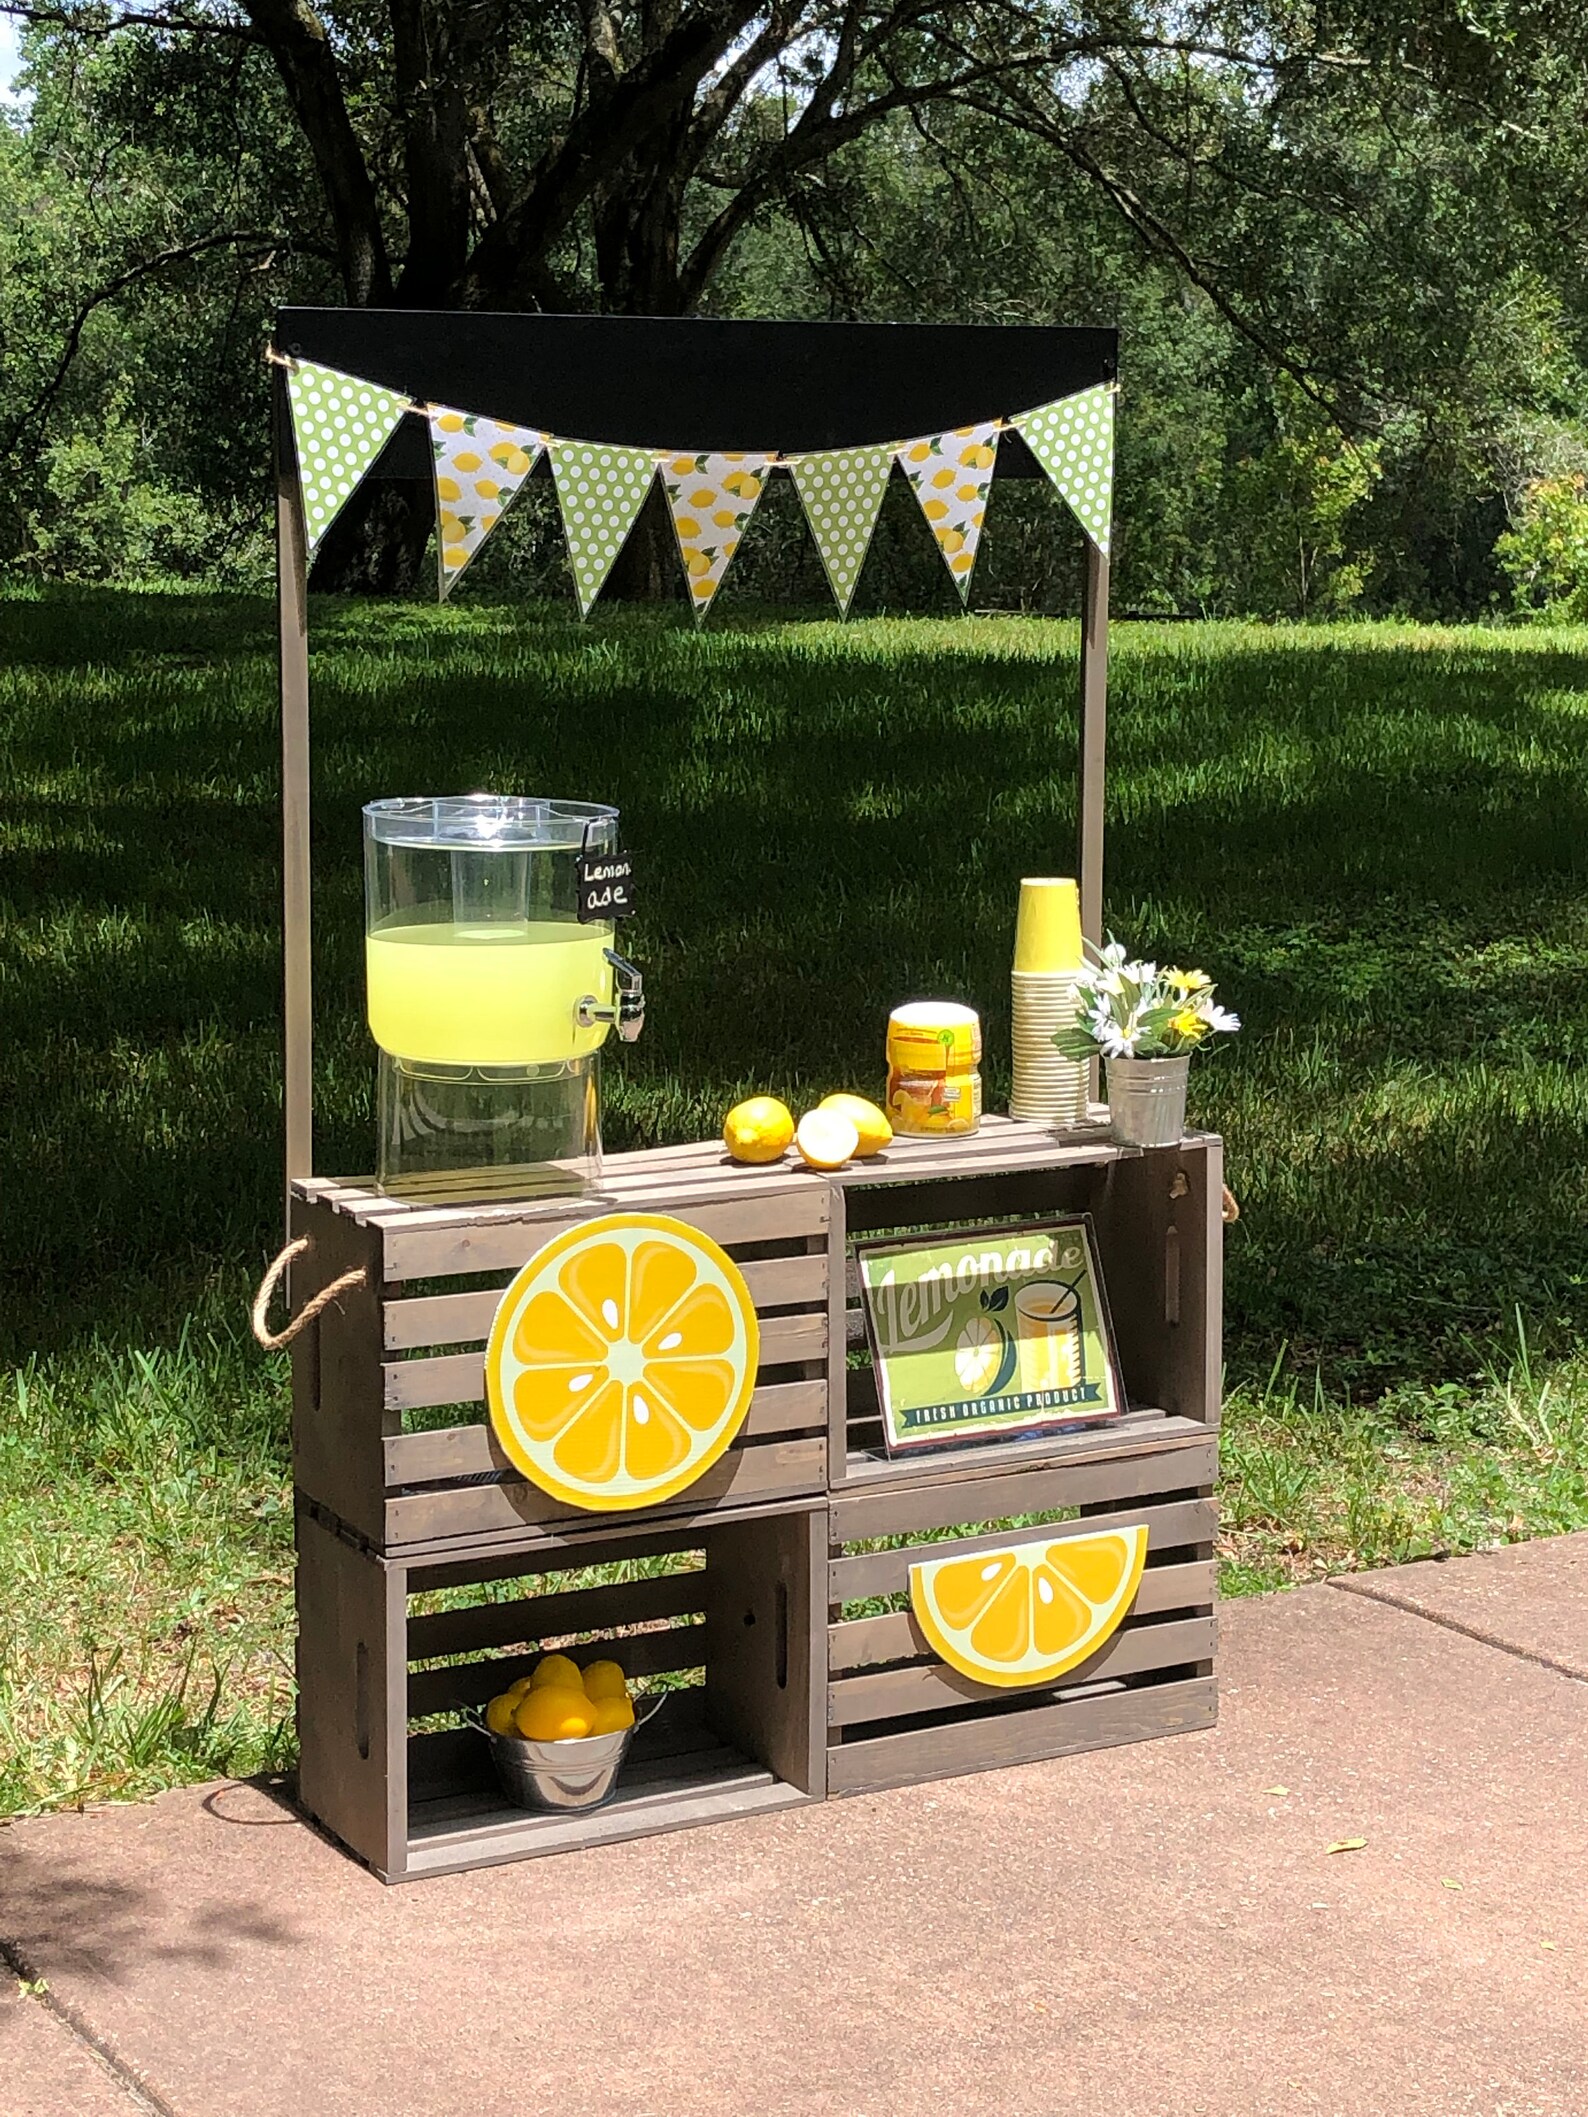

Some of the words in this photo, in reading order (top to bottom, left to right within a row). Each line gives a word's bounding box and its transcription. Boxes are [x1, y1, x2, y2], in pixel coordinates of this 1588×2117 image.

[587, 885, 628, 910] ade
[876, 1239, 1084, 1355] Lemonade
[915, 1405, 956, 1424] FRESH
[962, 1396, 1021, 1416] ORGANIC
[1026, 1387, 1087, 1408] PRODUCT
